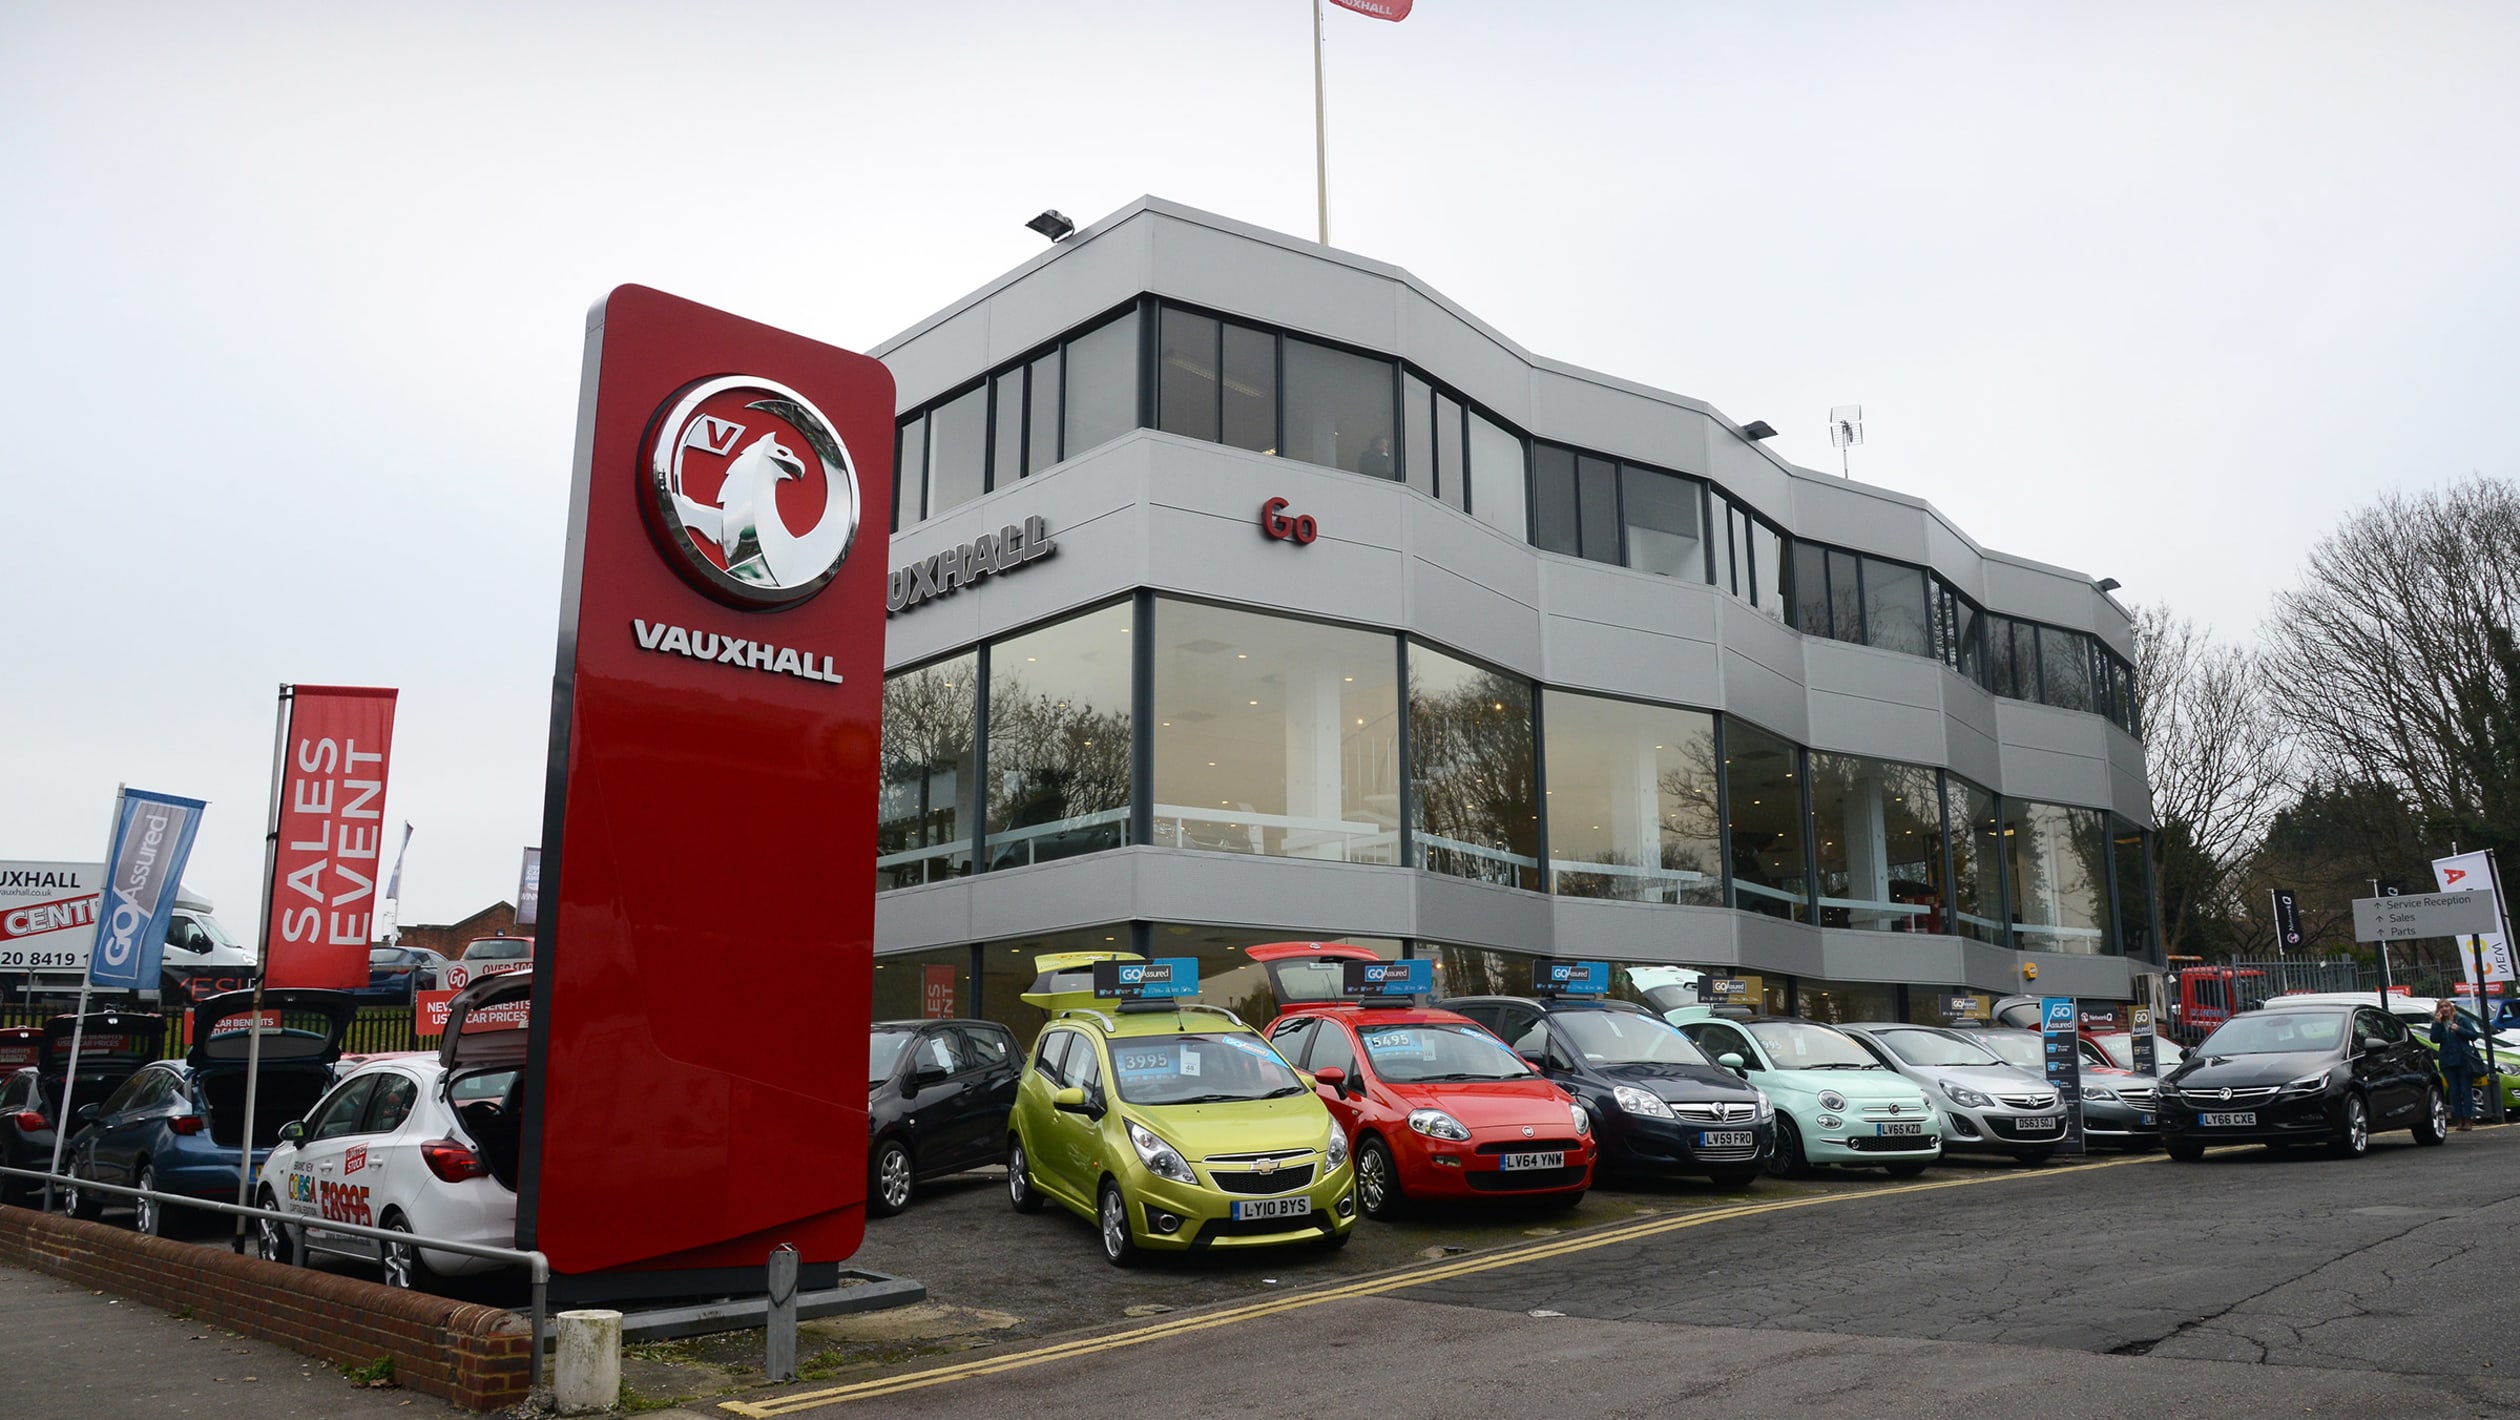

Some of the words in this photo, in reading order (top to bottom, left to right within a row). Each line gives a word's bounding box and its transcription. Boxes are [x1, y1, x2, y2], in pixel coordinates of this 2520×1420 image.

[1341, 0, 1393, 15] UXHALL
[1262, 497, 1318, 545] Go
[886, 513, 1054, 613] UXHALL
[633, 618, 844, 684] VAUXHALL
[282, 737, 338, 944] SALES
[329, 738, 382, 946] EVENT
[0, 871, 81, 888] UXHALL
[2386, 900, 2422, 910] Service
[2423, 896, 2472, 908] Reception
[2389, 914, 2416, 923] Sales
[2391, 926, 2416, 937] Parts
[30, 952, 75, 966] 8419
[489, 1011, 527, 1022] PRICES
[2052, 1007, 2071, 1018] GO
[2047, 1021, 2073, 1029] Assured
[1762, 1040, 1782, 1050] 995
[1125, 1053, 1168, 1069] 3995
[2204, 1114, 2232, 1124] LY66
[2233, 1113, 2255, 1124] CXE
[1705, 1133, 1732, 1144] LV59
[1507, 1154, 1538, 1168] LV64
[1540, 1153, 1562, 1166] YNW
[288, 1172, 318, 1204] CORSA
[1280, 1199, 1306, 1214] BYS
